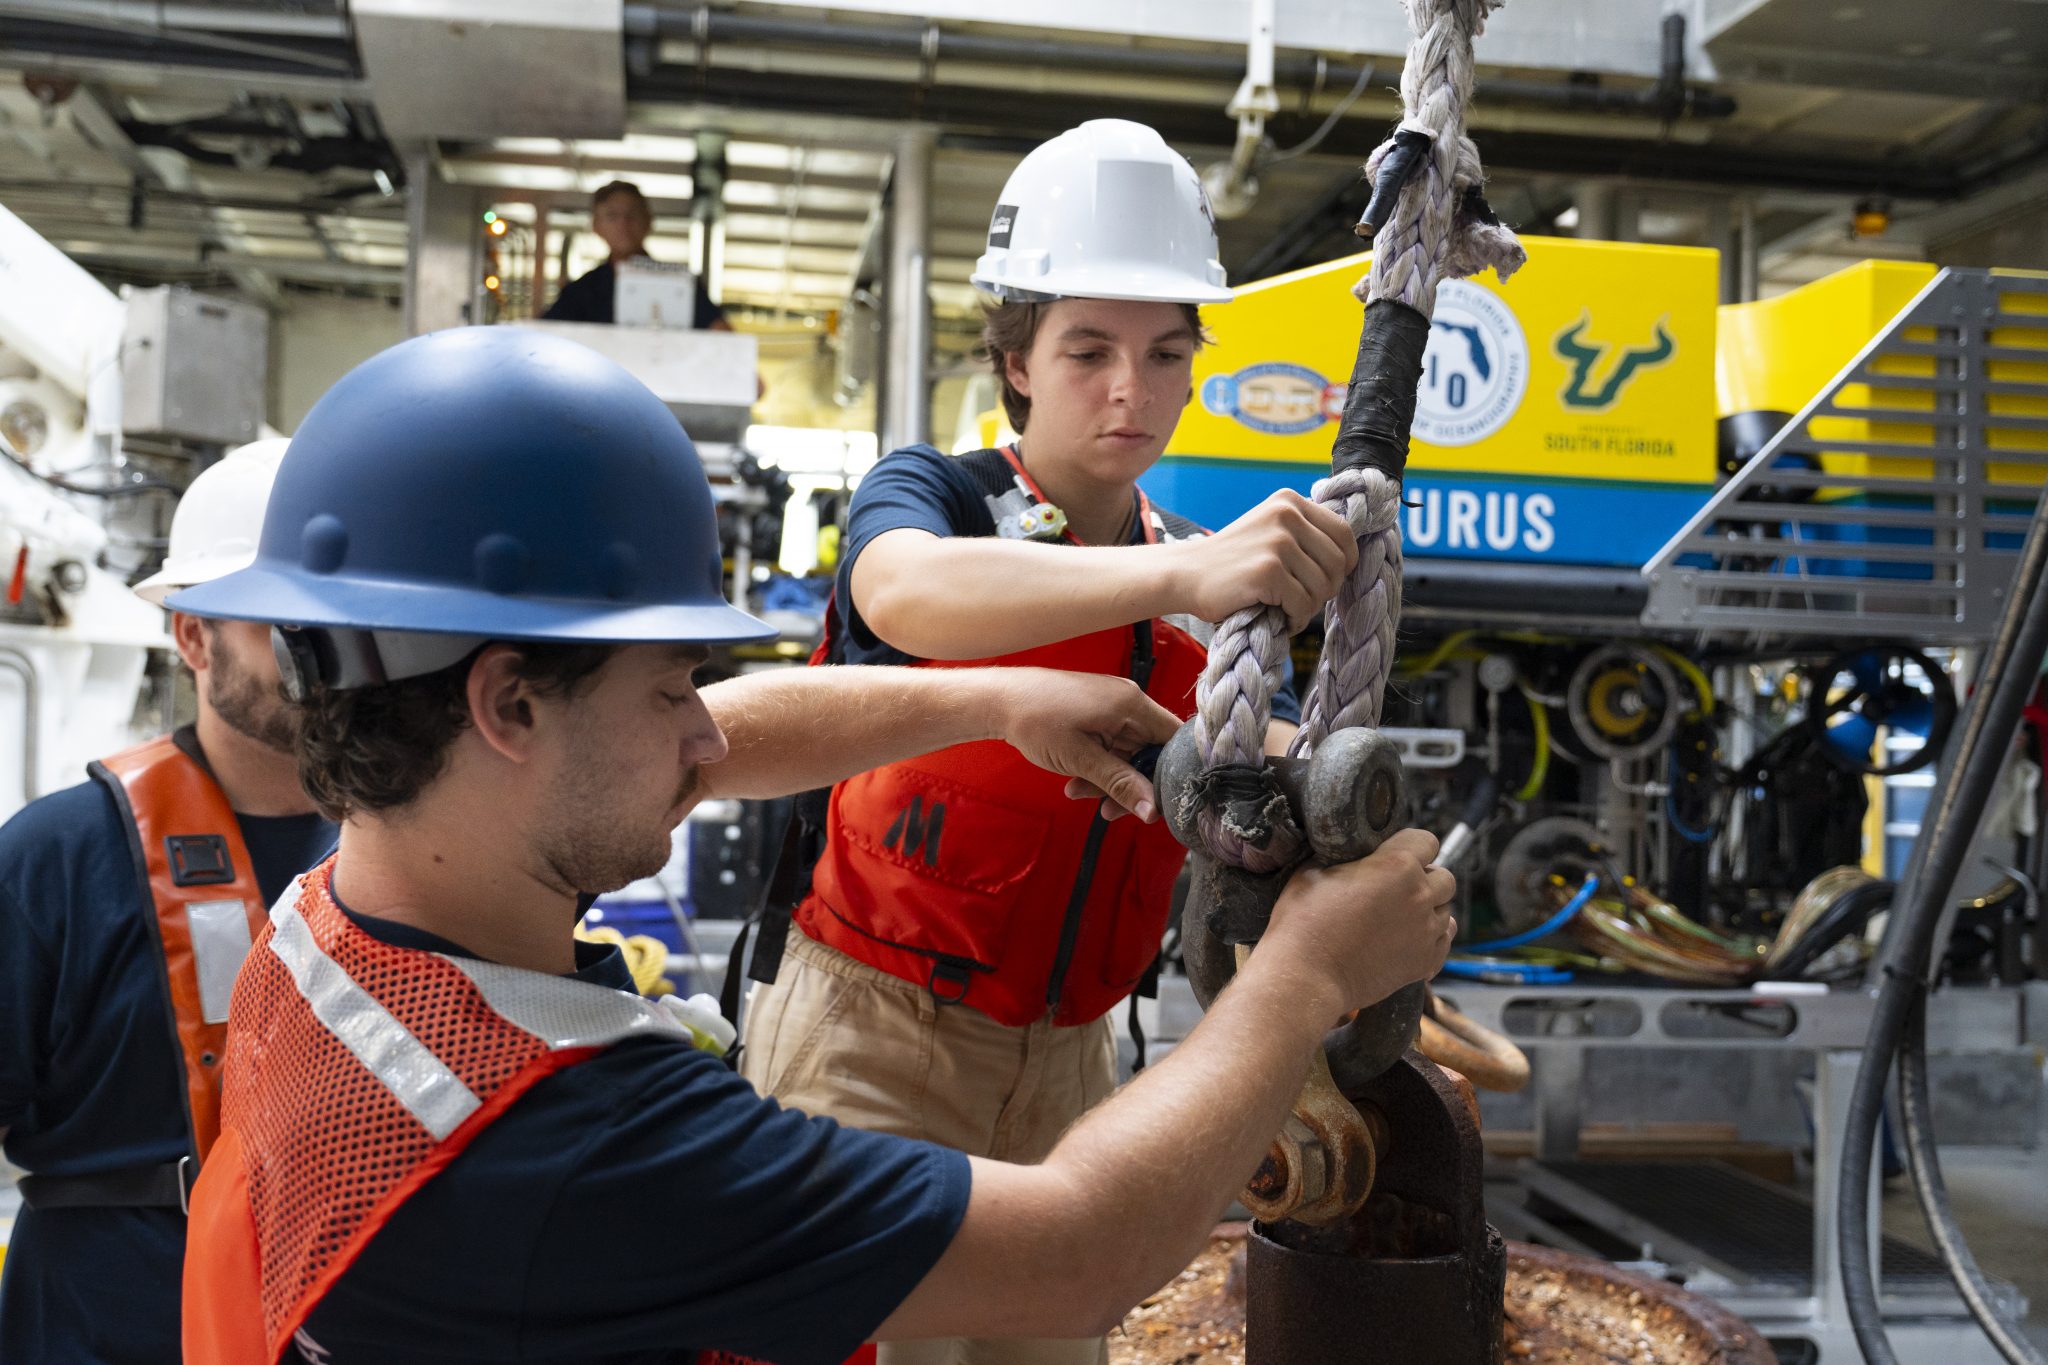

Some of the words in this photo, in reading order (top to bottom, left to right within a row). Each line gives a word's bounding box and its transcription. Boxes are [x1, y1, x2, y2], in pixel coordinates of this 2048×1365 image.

[1543, 432, 1602, 452] SOUTH
[1604, 436, 1677, 458] FLORIDA
[1405, 486, 1556, 553] URUS
